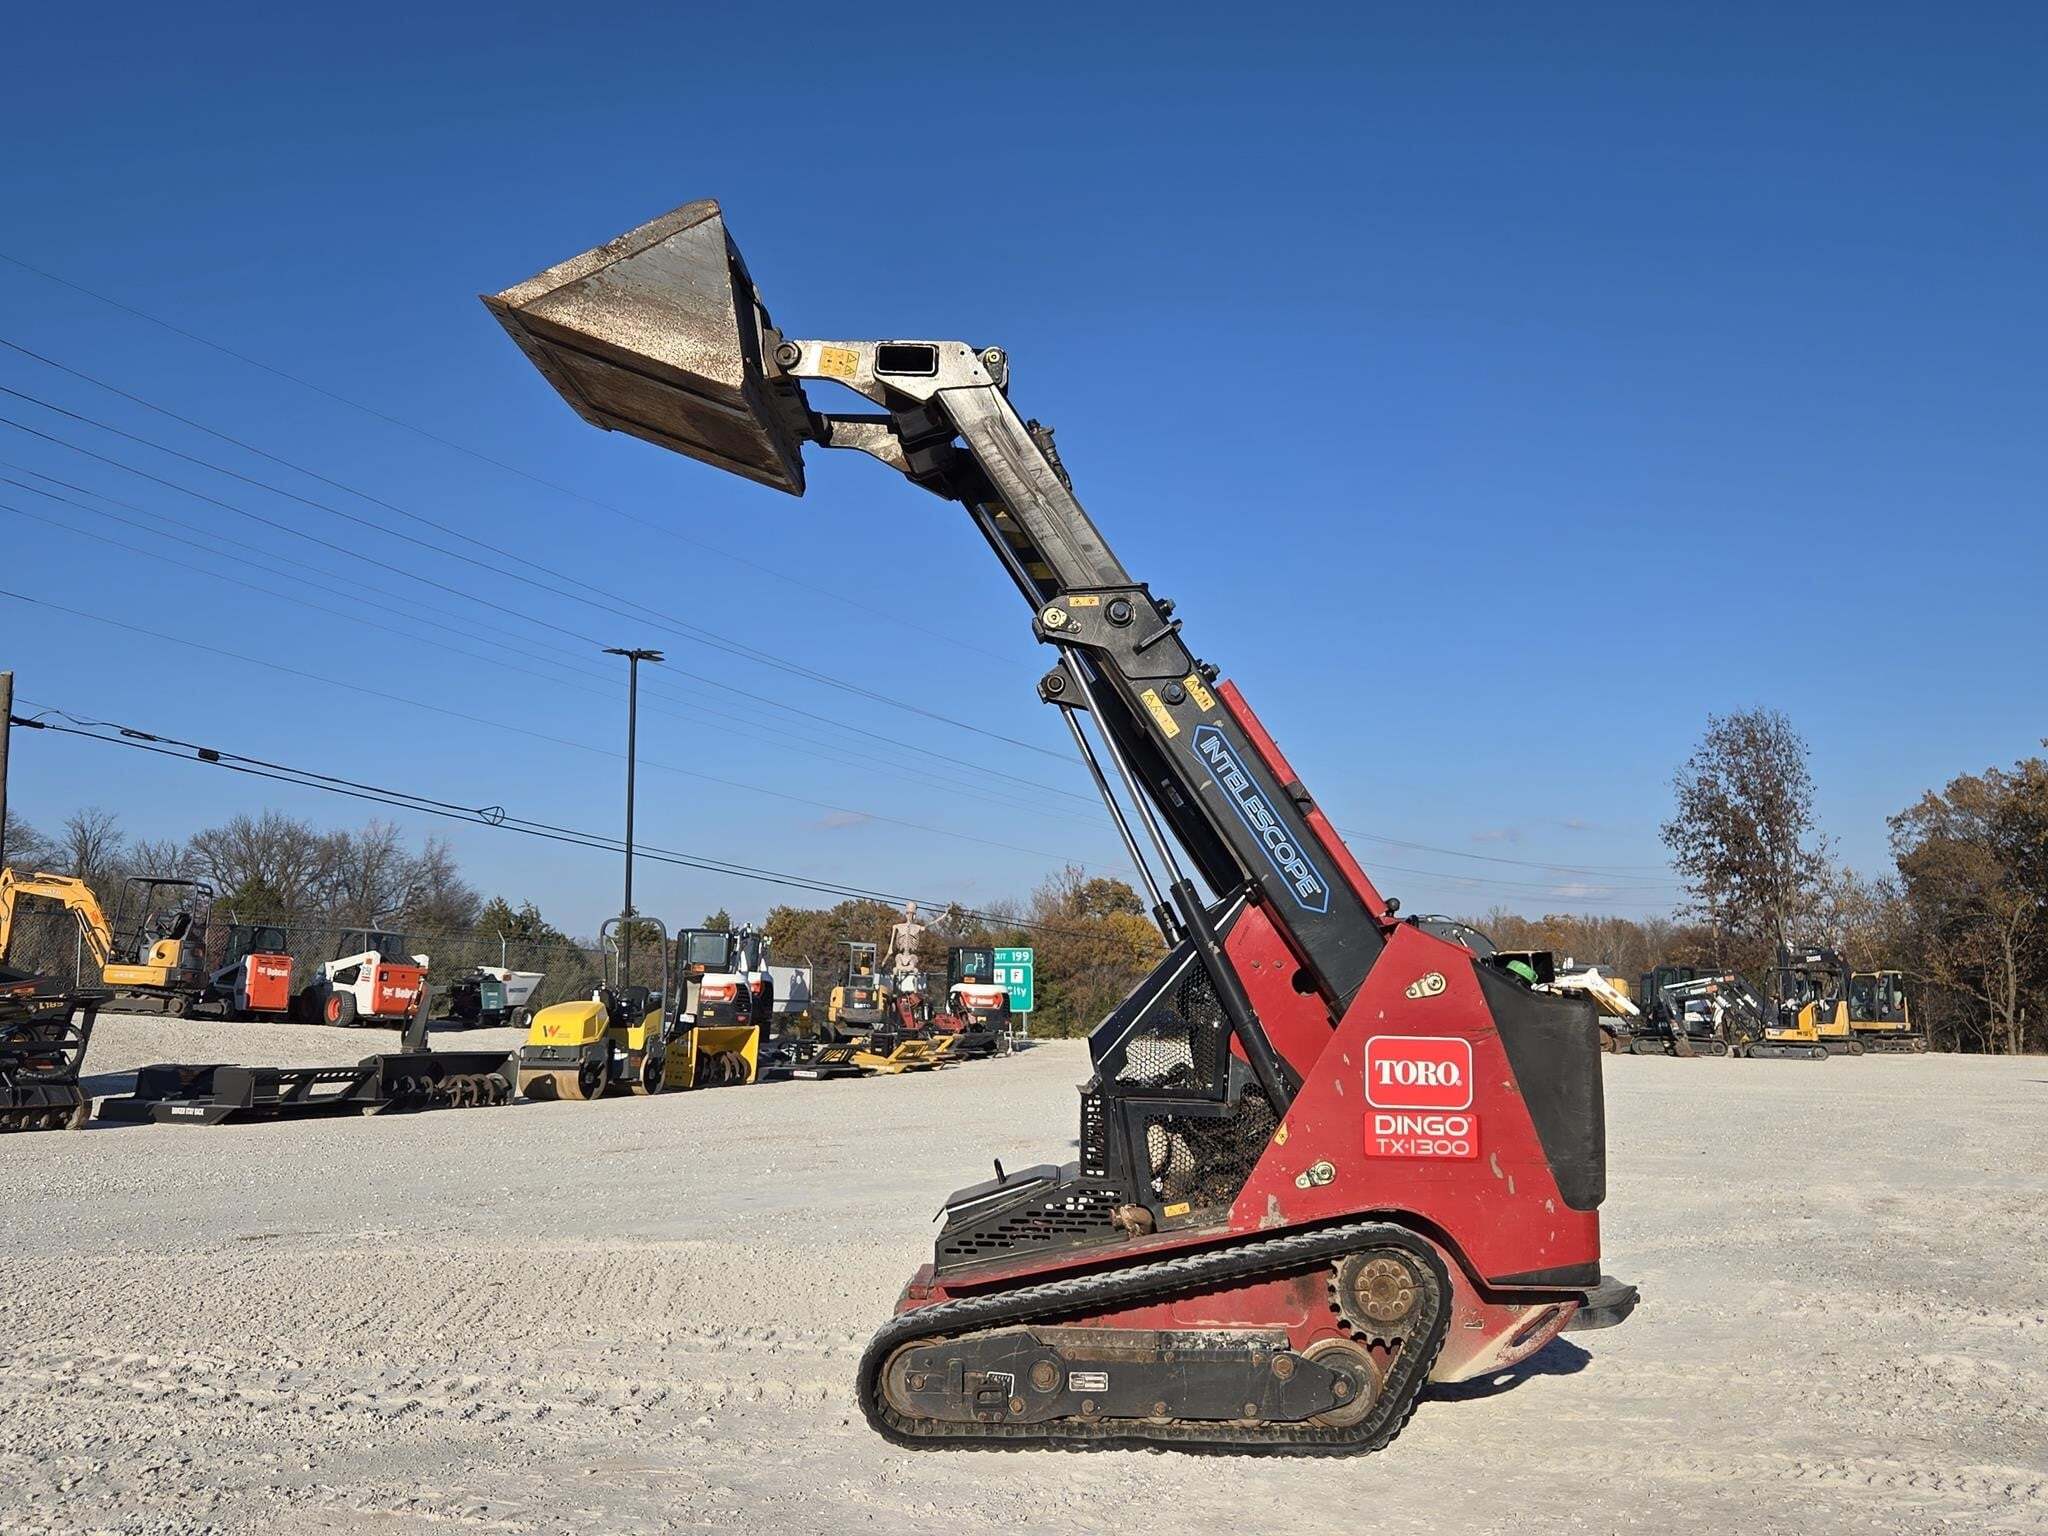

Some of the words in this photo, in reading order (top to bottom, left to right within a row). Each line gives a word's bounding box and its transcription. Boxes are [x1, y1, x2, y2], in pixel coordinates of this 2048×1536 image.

[1200, 735, 1318, 899] INTELESCOPE
[994, 952, 1007, 961] XIT
[1012, 951, 1030, 961] 199
[996, 970, 1003, 981] H
[1014, 971, 1020, 981] F
[1375, 1060, 1460, 1087] TORO
[1375, 1115, 1469, 1137] DINGO
